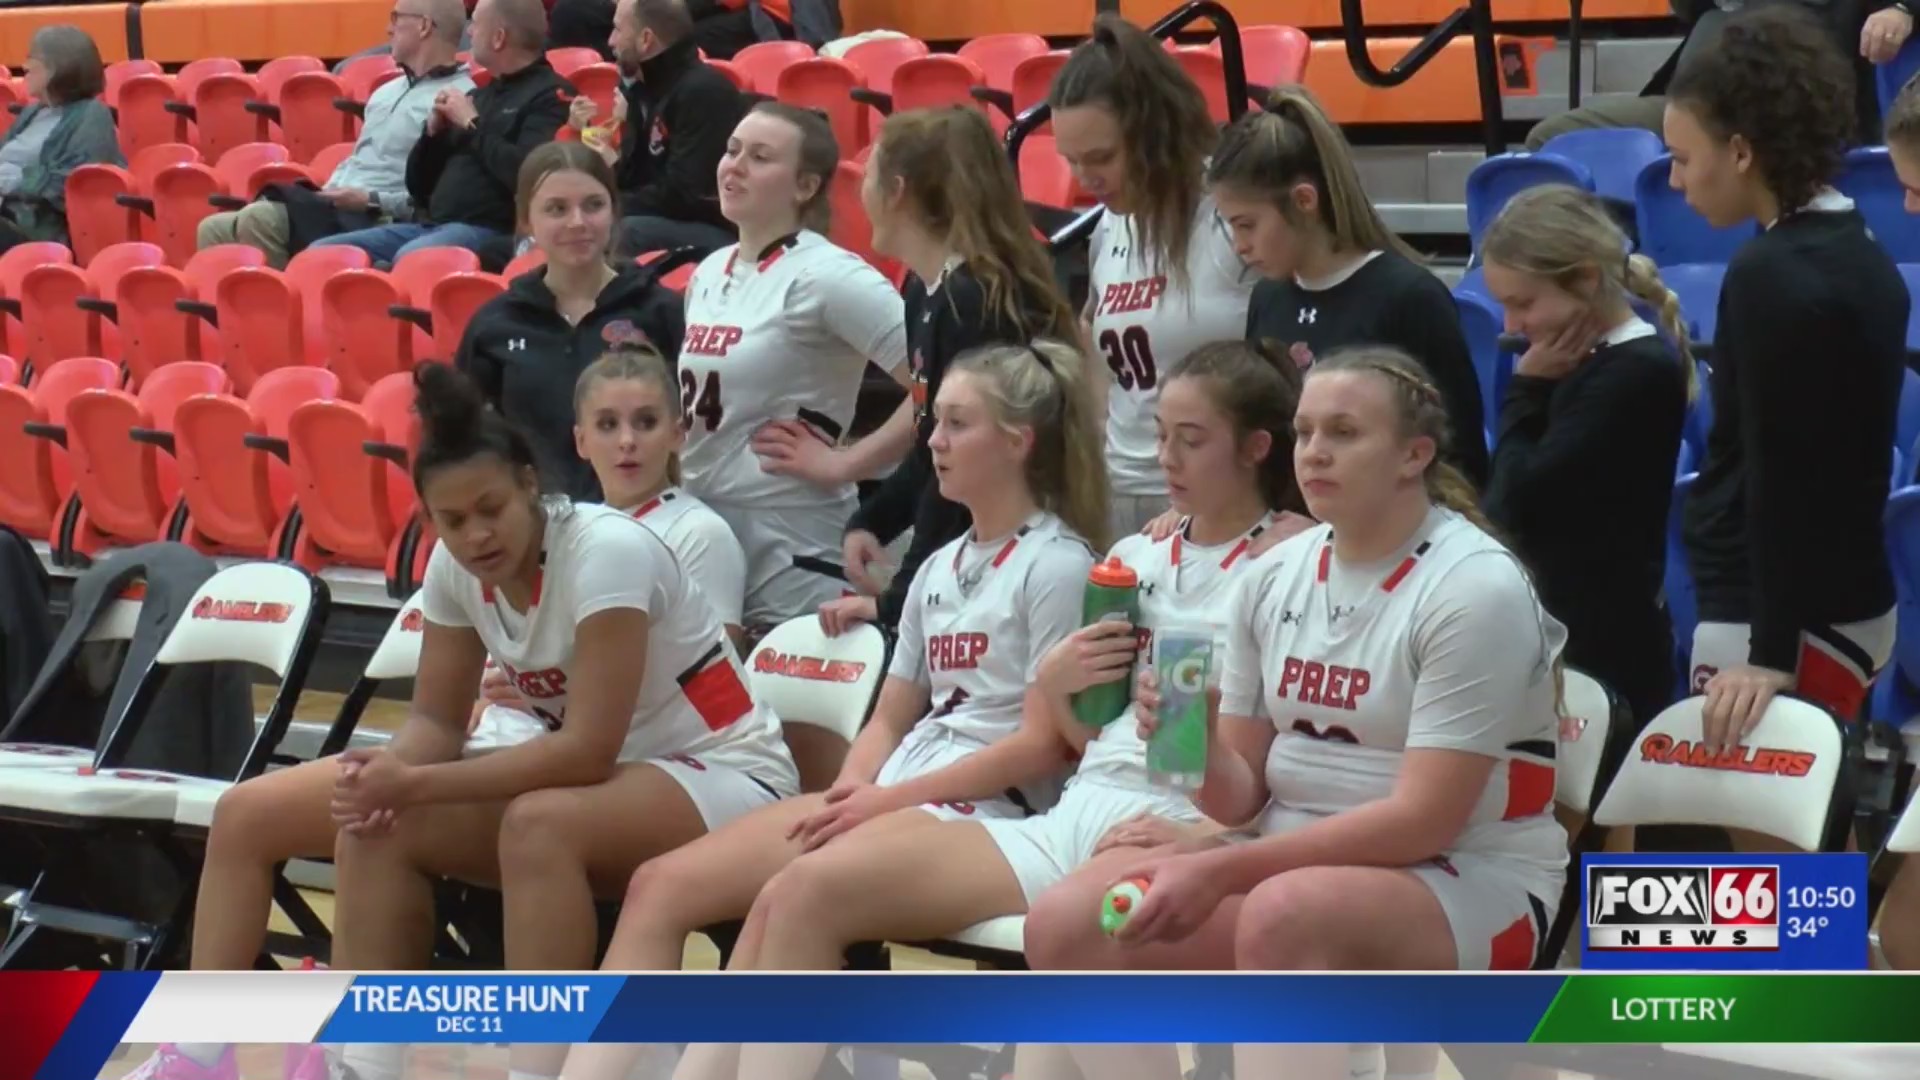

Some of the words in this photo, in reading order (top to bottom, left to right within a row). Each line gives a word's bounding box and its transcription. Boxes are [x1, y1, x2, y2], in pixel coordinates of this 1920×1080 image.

[1097, 276, 1168, 316] PREP
[1099, 325, 1157, 391] 20
[681, 368, 723, 433] 24
[929, 632, 989, 672] PREP
[1277, 656, 1371, 711] PREP
[1641, 732, 1817, 778] RAMBLERS
